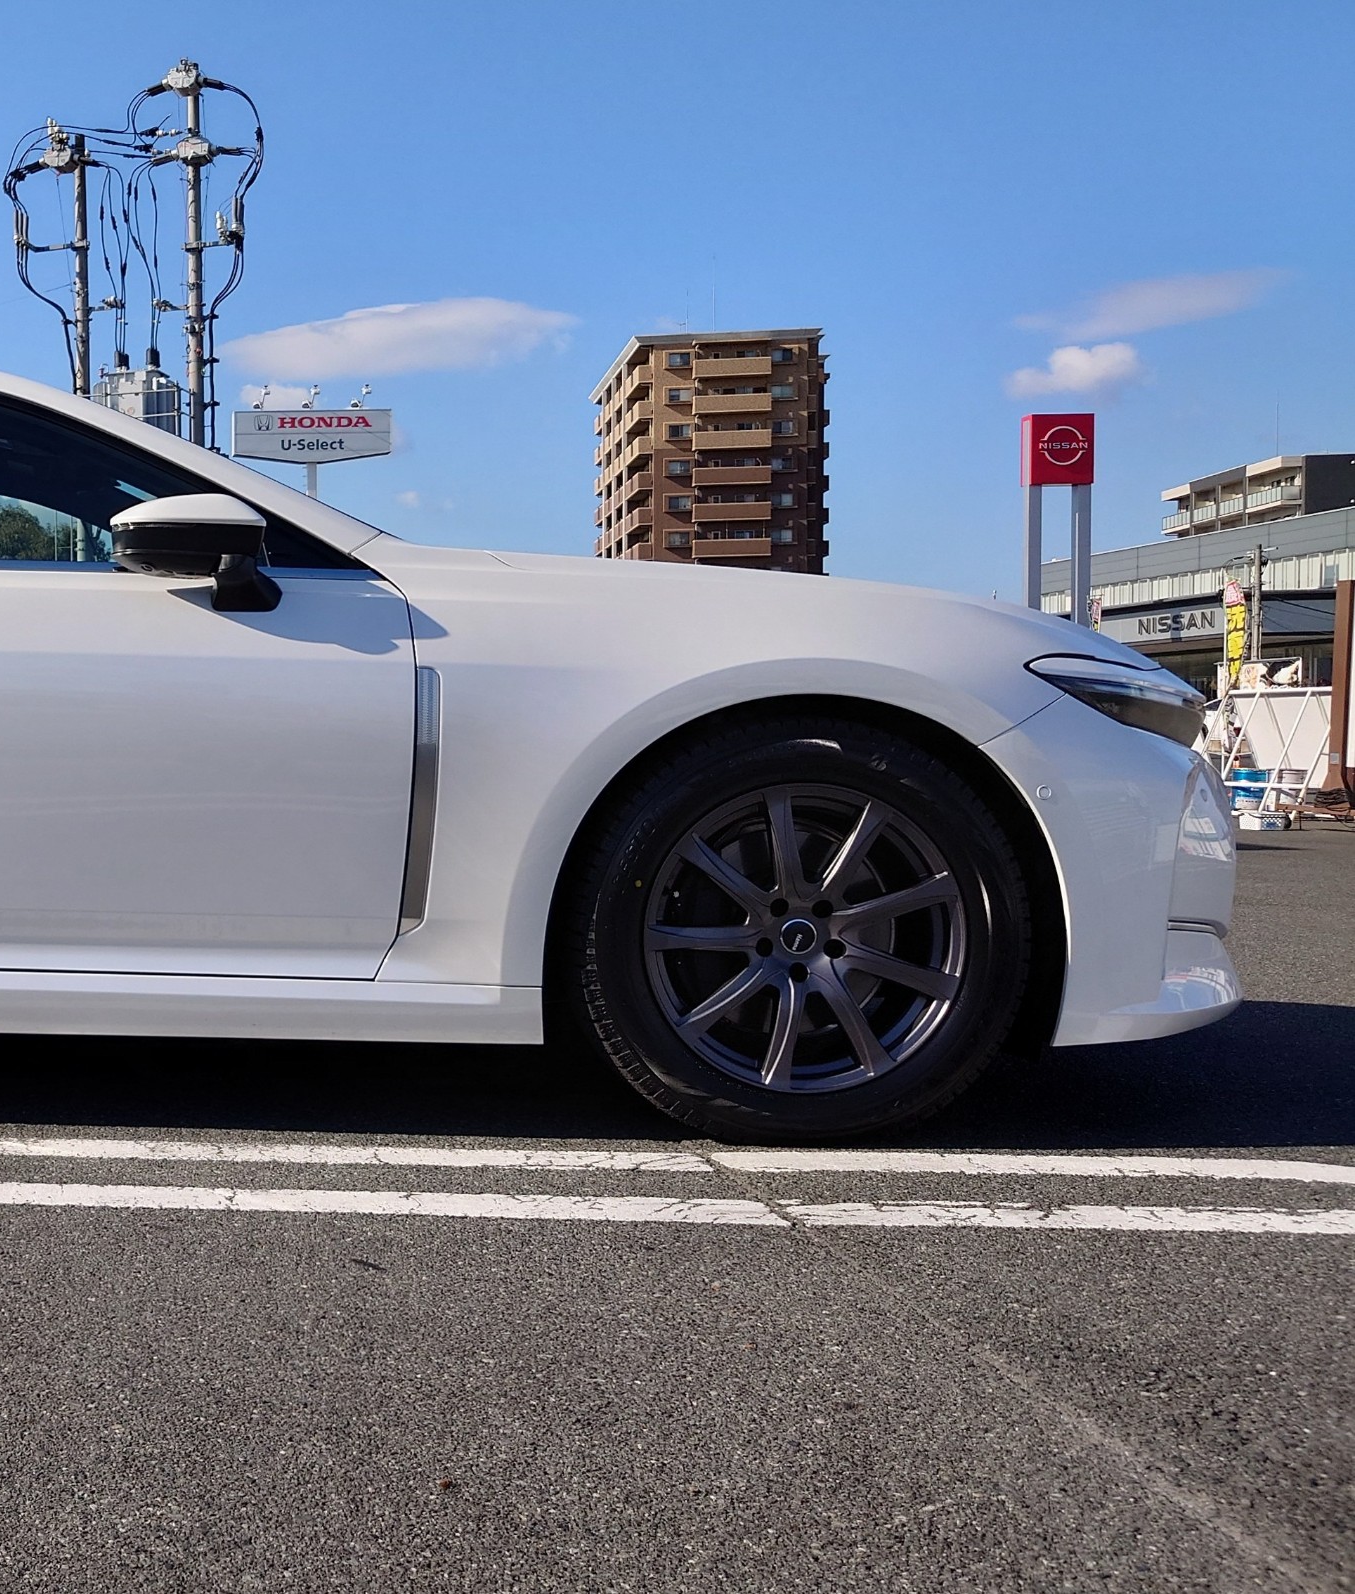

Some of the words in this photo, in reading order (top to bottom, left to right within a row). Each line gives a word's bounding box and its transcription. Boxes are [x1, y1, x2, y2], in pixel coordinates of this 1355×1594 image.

[277, 416, 372, 429] HONDA
[280, 438, 345, 451] U-Select
[1138, 611, 1215, 635] NISSAN
